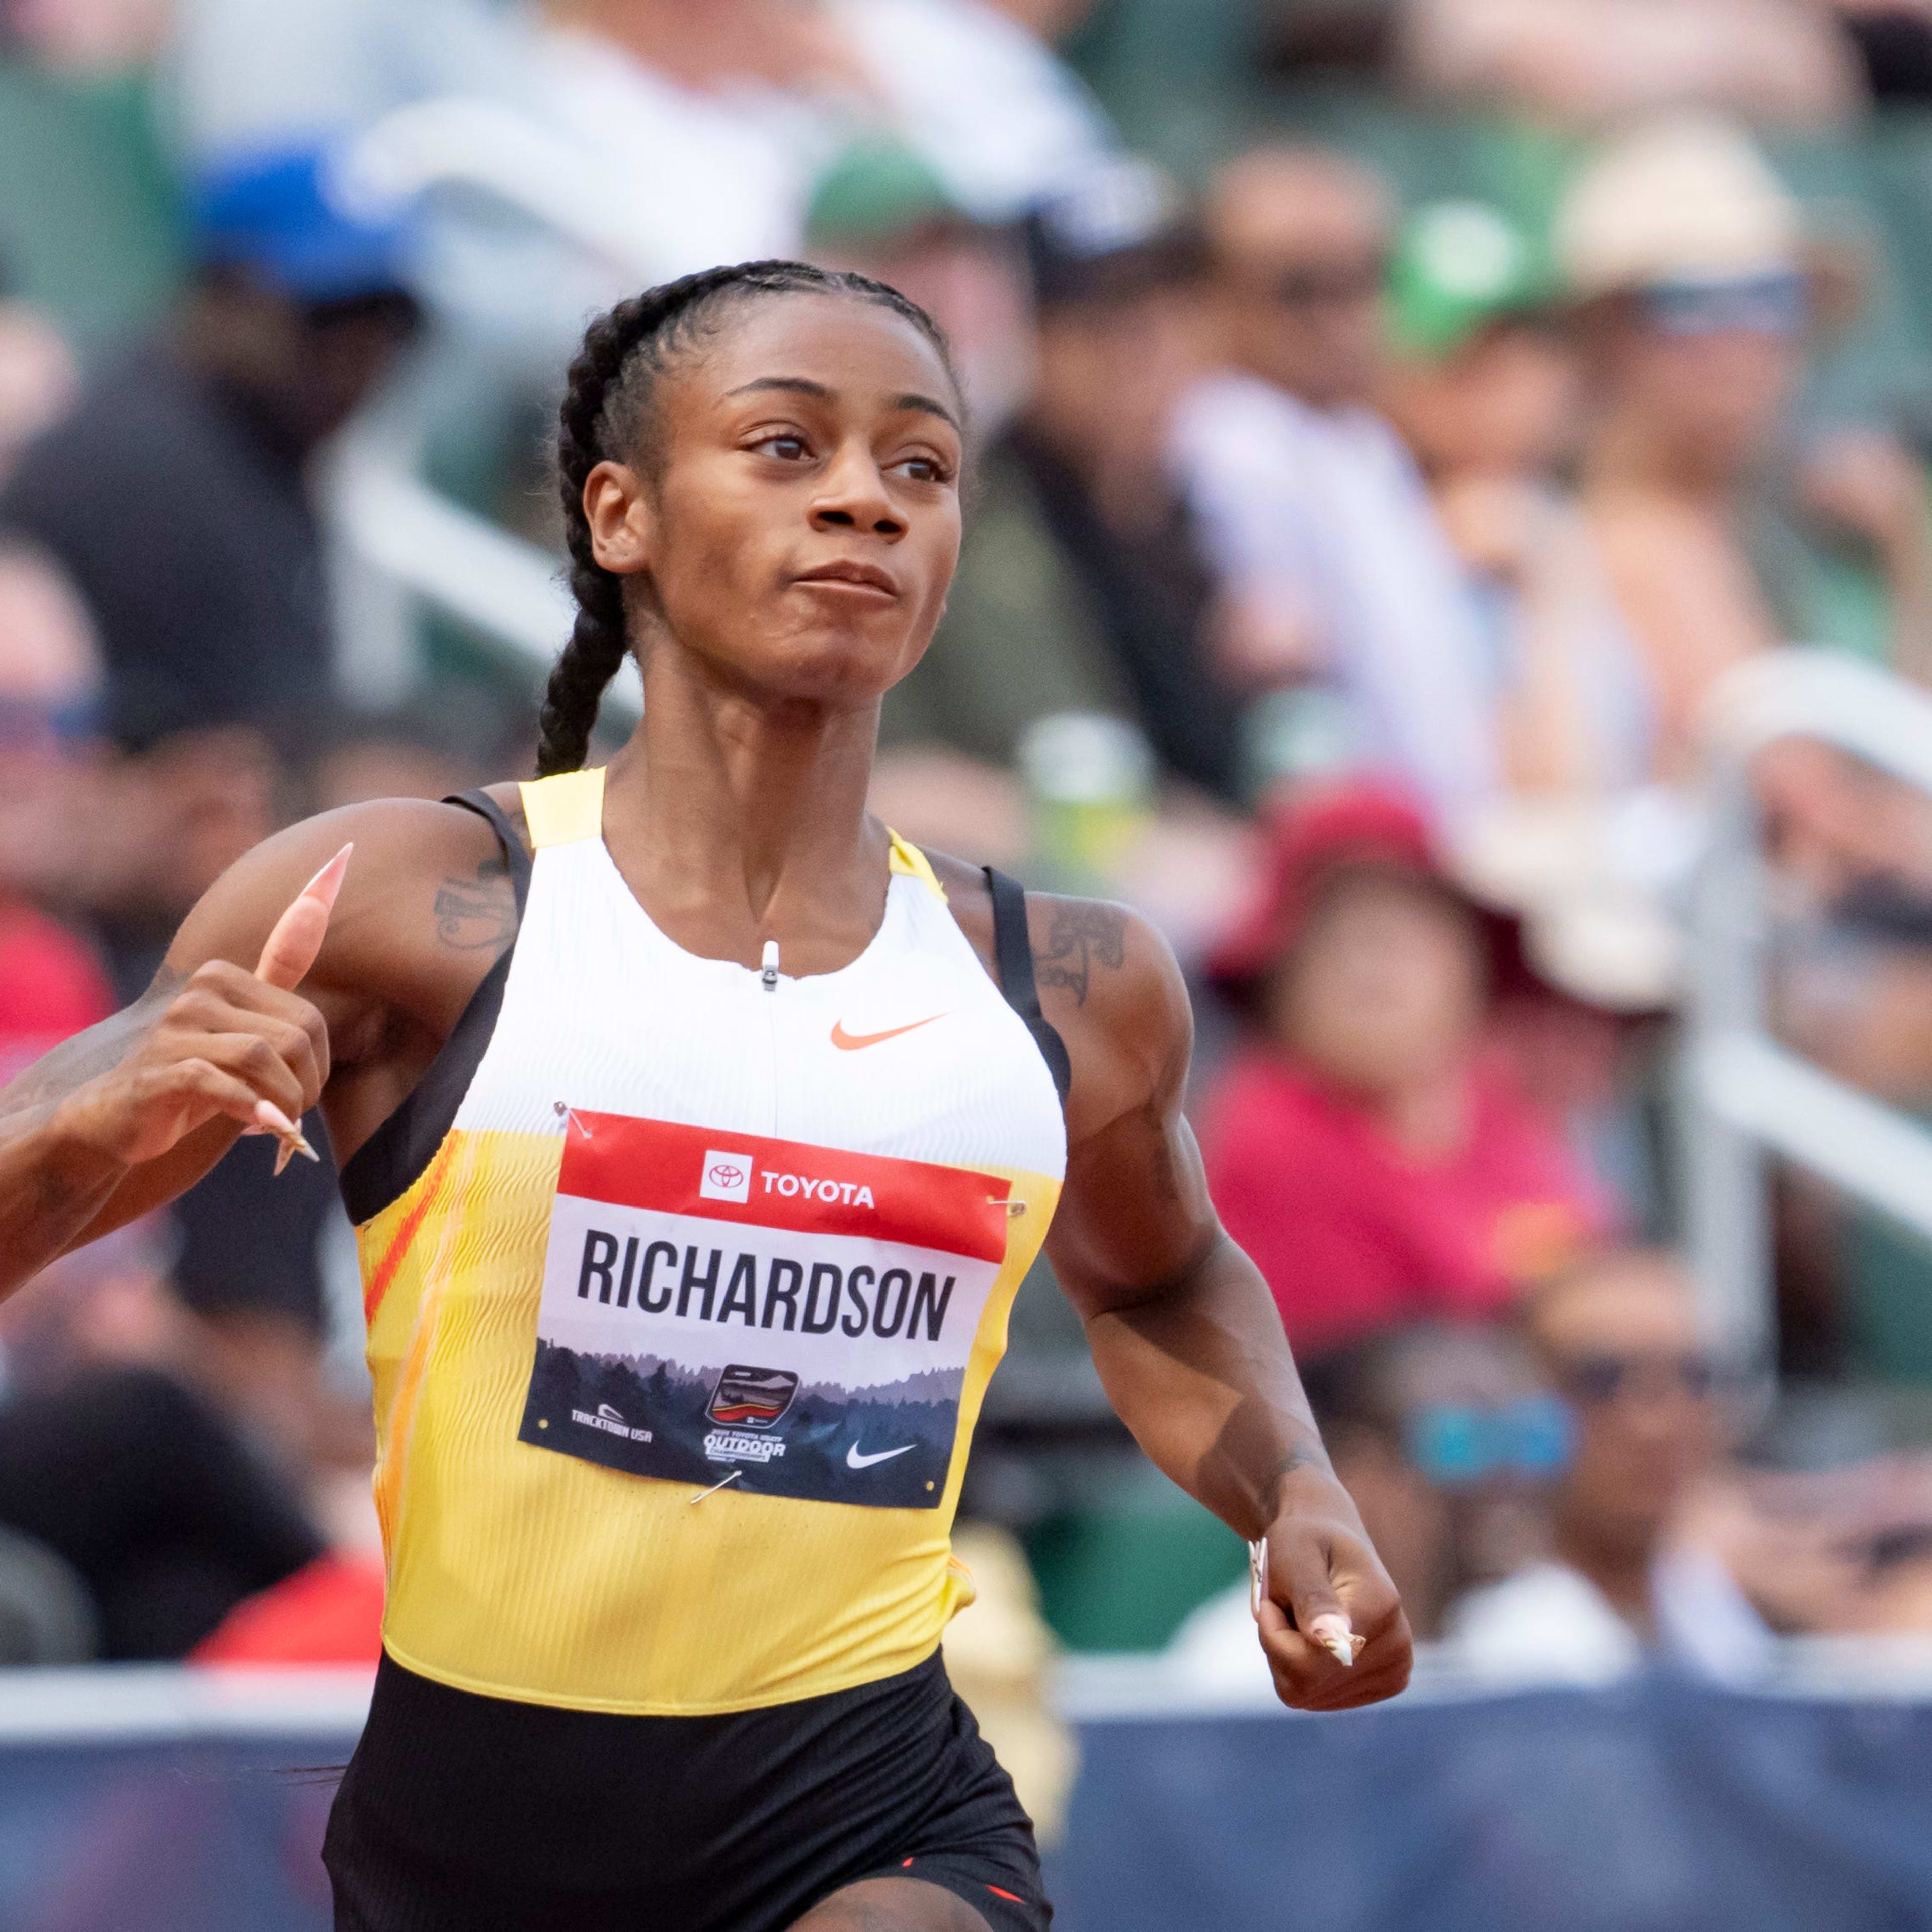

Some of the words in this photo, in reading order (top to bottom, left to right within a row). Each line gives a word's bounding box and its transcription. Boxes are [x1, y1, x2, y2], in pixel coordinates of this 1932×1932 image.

[761, 1171, 875, 1209] TOYOTA
[577, 1229, 956, 1341] RICHARDSON
[631, 1428, 653, 1443] USA
[704, 1434, 786, 1456] OUTDOOR
